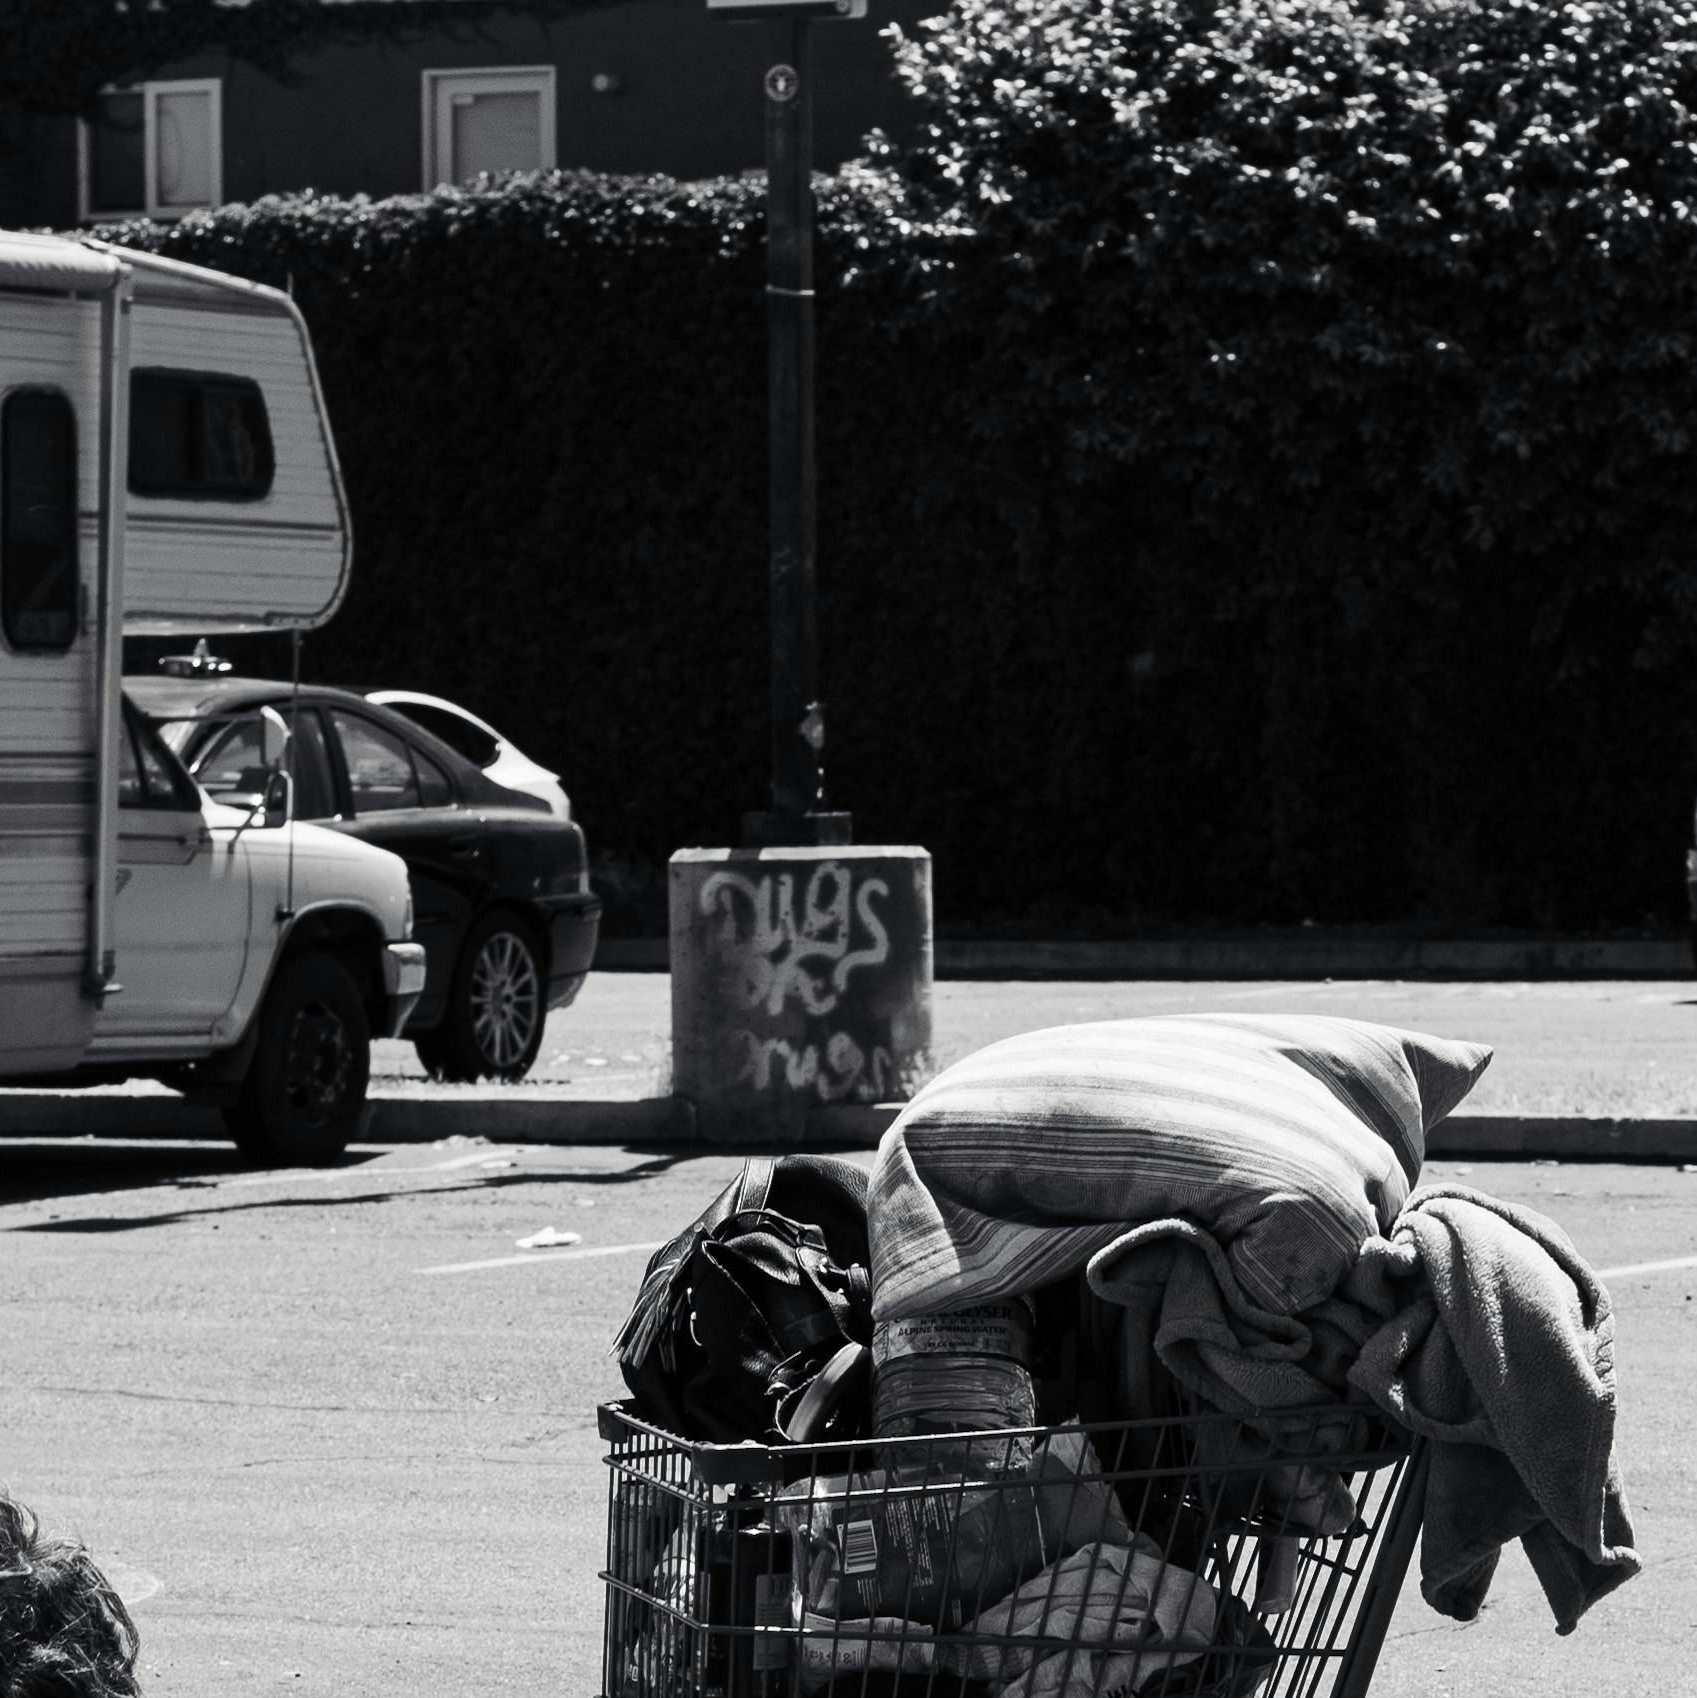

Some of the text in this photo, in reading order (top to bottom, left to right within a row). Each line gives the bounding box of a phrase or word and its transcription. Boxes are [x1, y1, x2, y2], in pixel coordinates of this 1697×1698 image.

[919, 1318, 986, 1326] NATURAL
[897, 1325, 1007, 1337] ALPINE SPRING WATER
